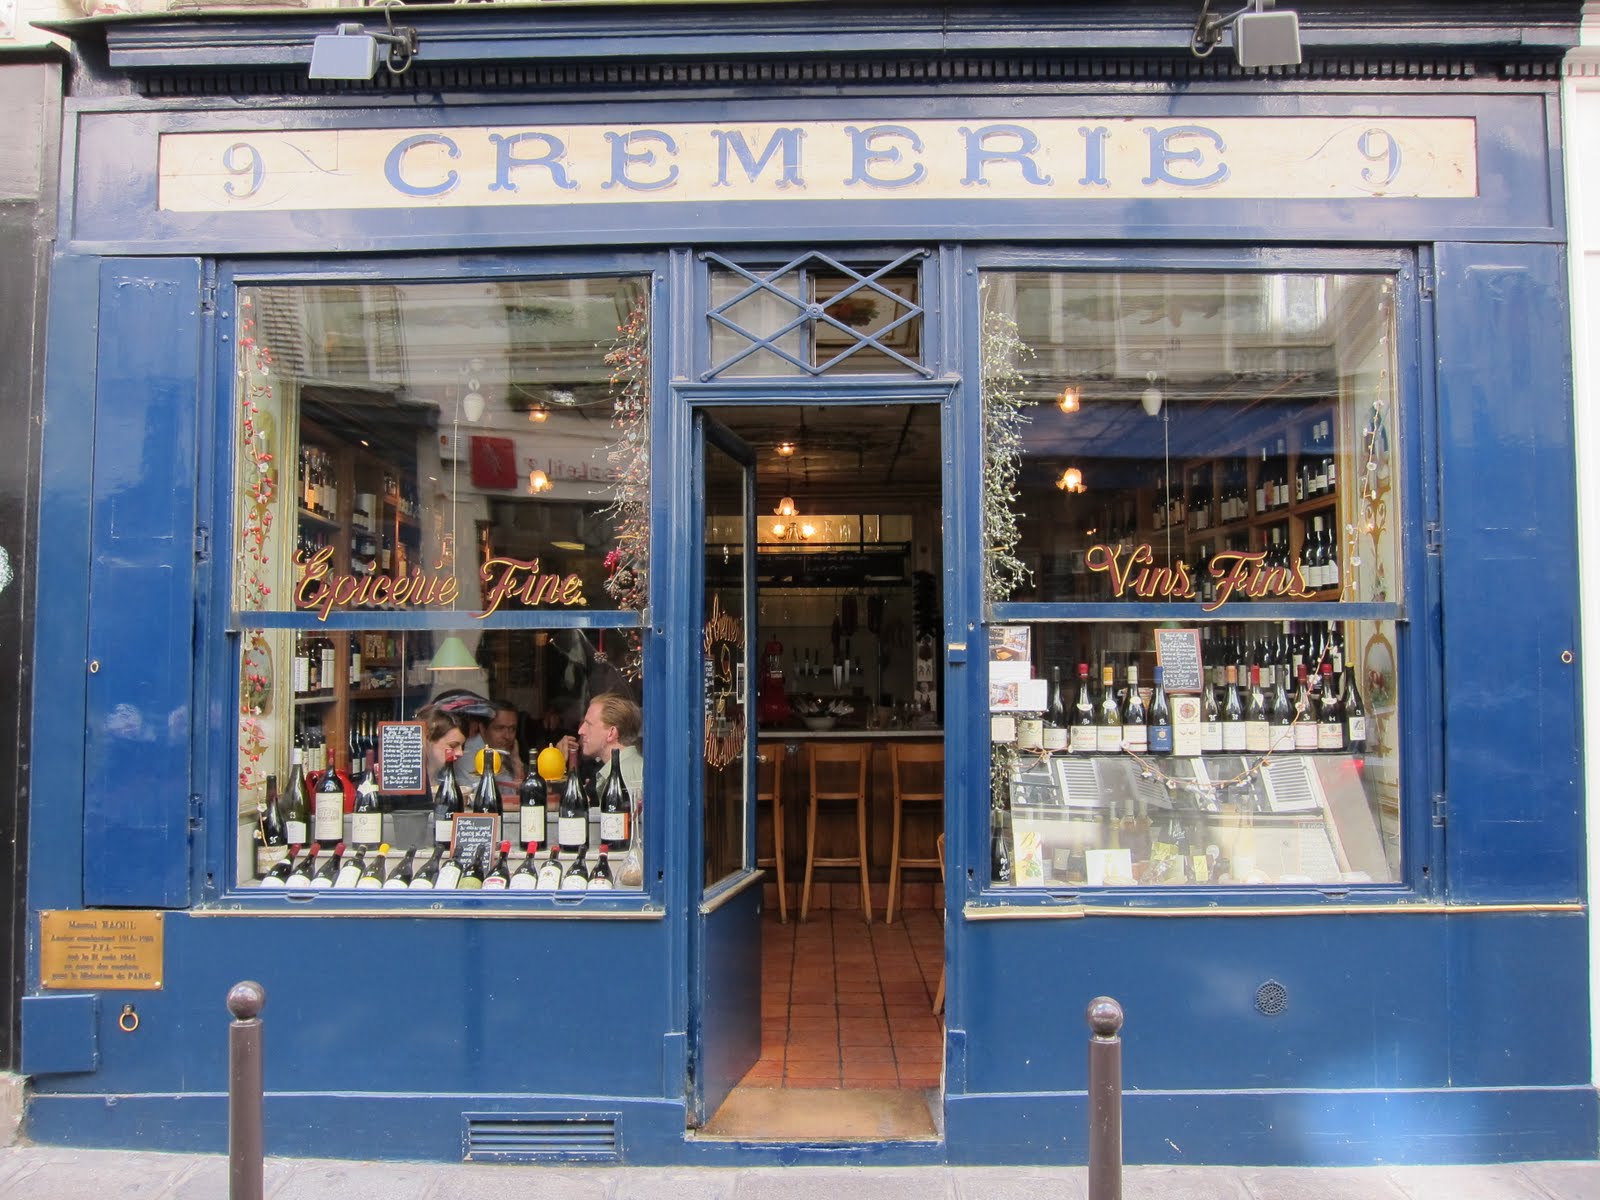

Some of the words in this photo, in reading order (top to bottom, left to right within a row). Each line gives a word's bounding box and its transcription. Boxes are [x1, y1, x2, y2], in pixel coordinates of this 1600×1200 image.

[222, 141, 266, 198] 9
[384, 123, 1231, 197] CREMERIE
[1357, 127, 1402, 187] 9
[468, 556, 582, 619] Fine
[1083, 543, 1196, 598] Vins
[1202, 550, 1317, 612] Fins
